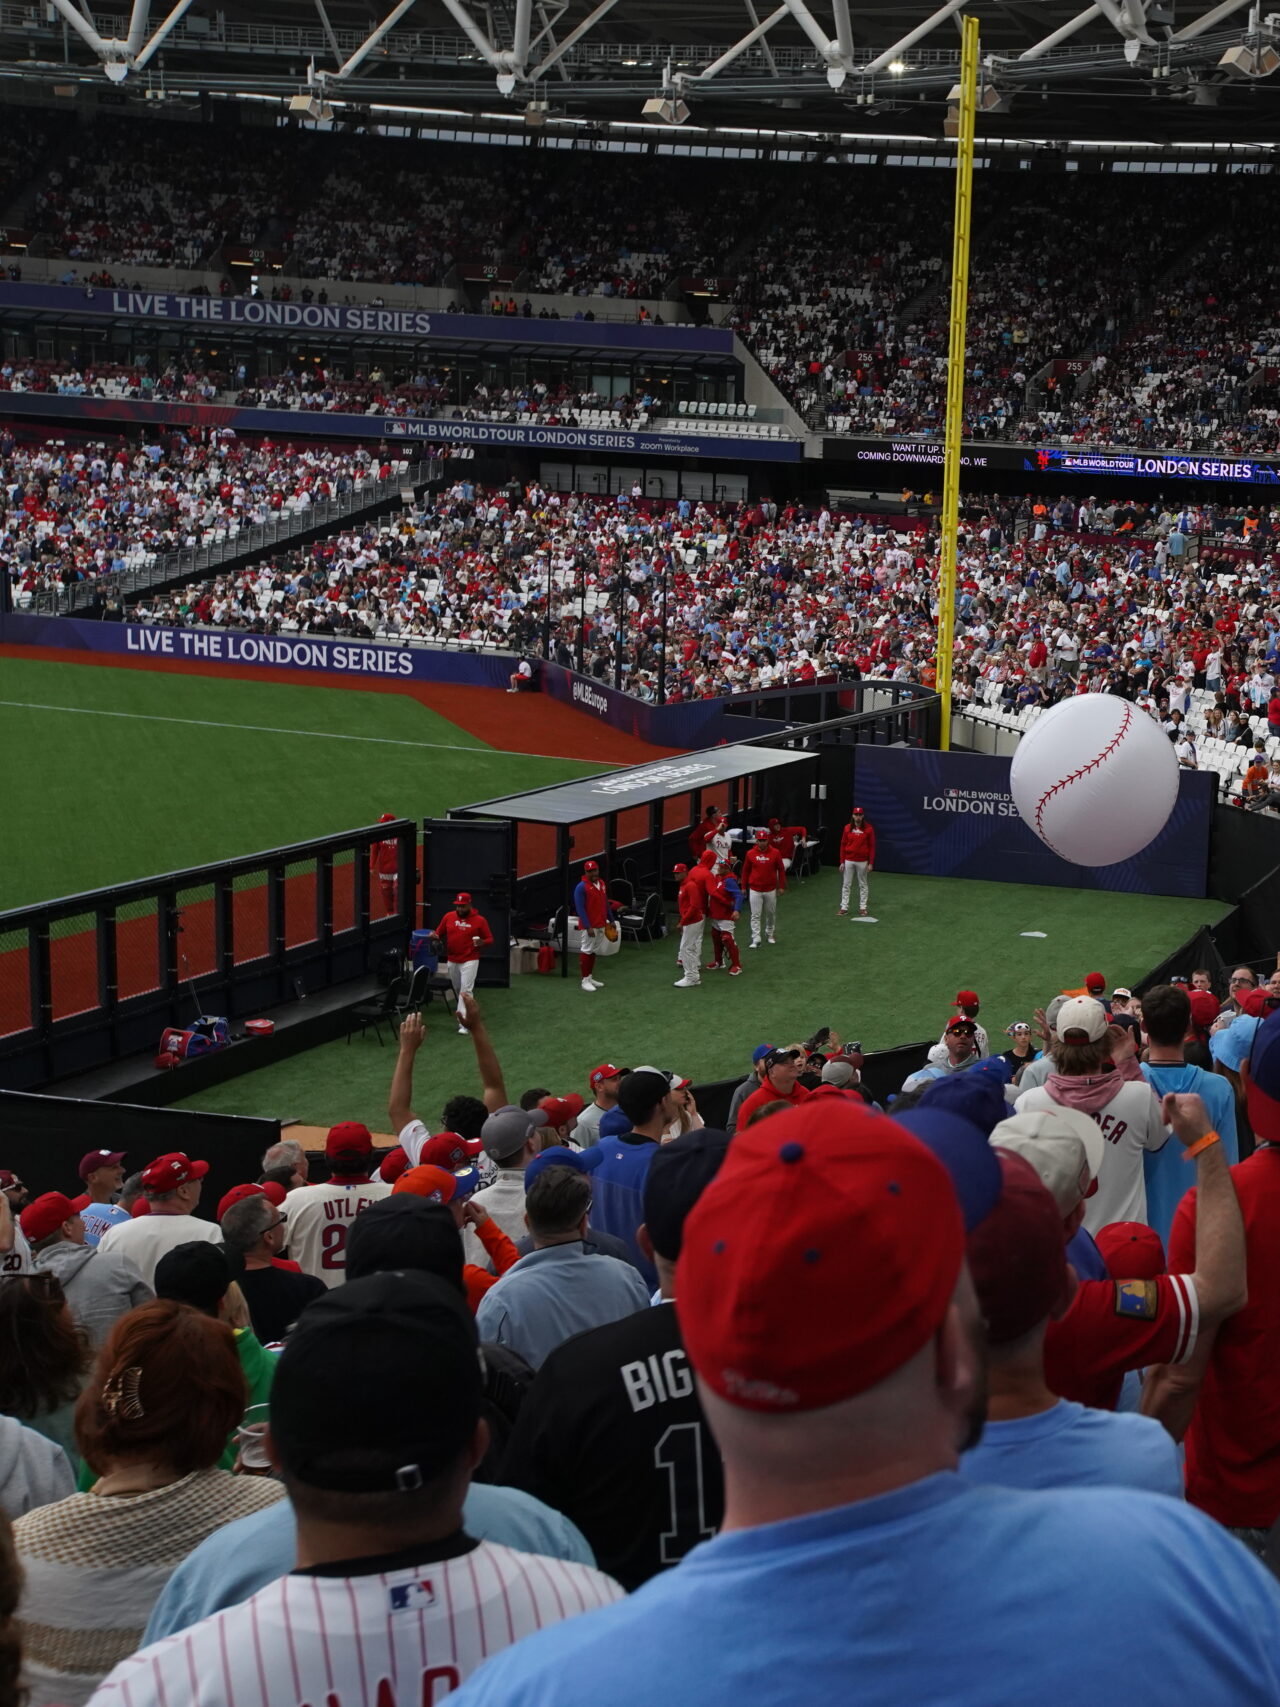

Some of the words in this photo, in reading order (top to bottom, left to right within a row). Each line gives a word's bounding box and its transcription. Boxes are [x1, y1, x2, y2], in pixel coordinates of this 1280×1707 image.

[249, 249, 265, 258] 203
[483, 265, 498, 274] 202
[704, 278, 718, 287] 201
[113, 292, 168, 316] LIVE
[175, 297, 223, 319] THE
[230, 301, 340, 328] LONDON
[346, 309, 431, 334] SERIES
[858, 353, 873, 362] 256
[1067, 362, 1082, 371] 255
[408, 423, 437, 436] MLB
[440, 425, 488, 440] WORLD
[489, 428, 526, 442] TOUR
[529, 430, 586, 446] LONDON
[589, 434, 635, 449] SERIES
[640, 442, 662, 450] zoom
[664, 443, 700, 453] Workplace
[892, 442, 916, 453] WANT
[918, 444, 926, 453] IT
[928, 445, 941, 455] UP.
[857, 451, 891, 462] COMING
[974, 458, 988, 467] WE
[1073, 458, 1089, 466] MLB
[1089, 459, 1115, 468] WORLD
[1115, 461, 1134, 469] TOUR
[1137, 458, 1199, 476] LONDON
[1202, 461, 1252, 478] SERIES
[127, 628, 174, 653] LIVE
[180, 632, 222, 658] THE
[228, 636, 328, 668] LONDON
[333, 646, 414, 675] SERIES
[572, 681, 608, 715] @MLBEurope
[958, 790, 976, 799] MLB
[977, 791, 1010, 801] WORLD
[923, 796, 995, 816] LONDON
[619, 1347, 695, 1413] BIG
